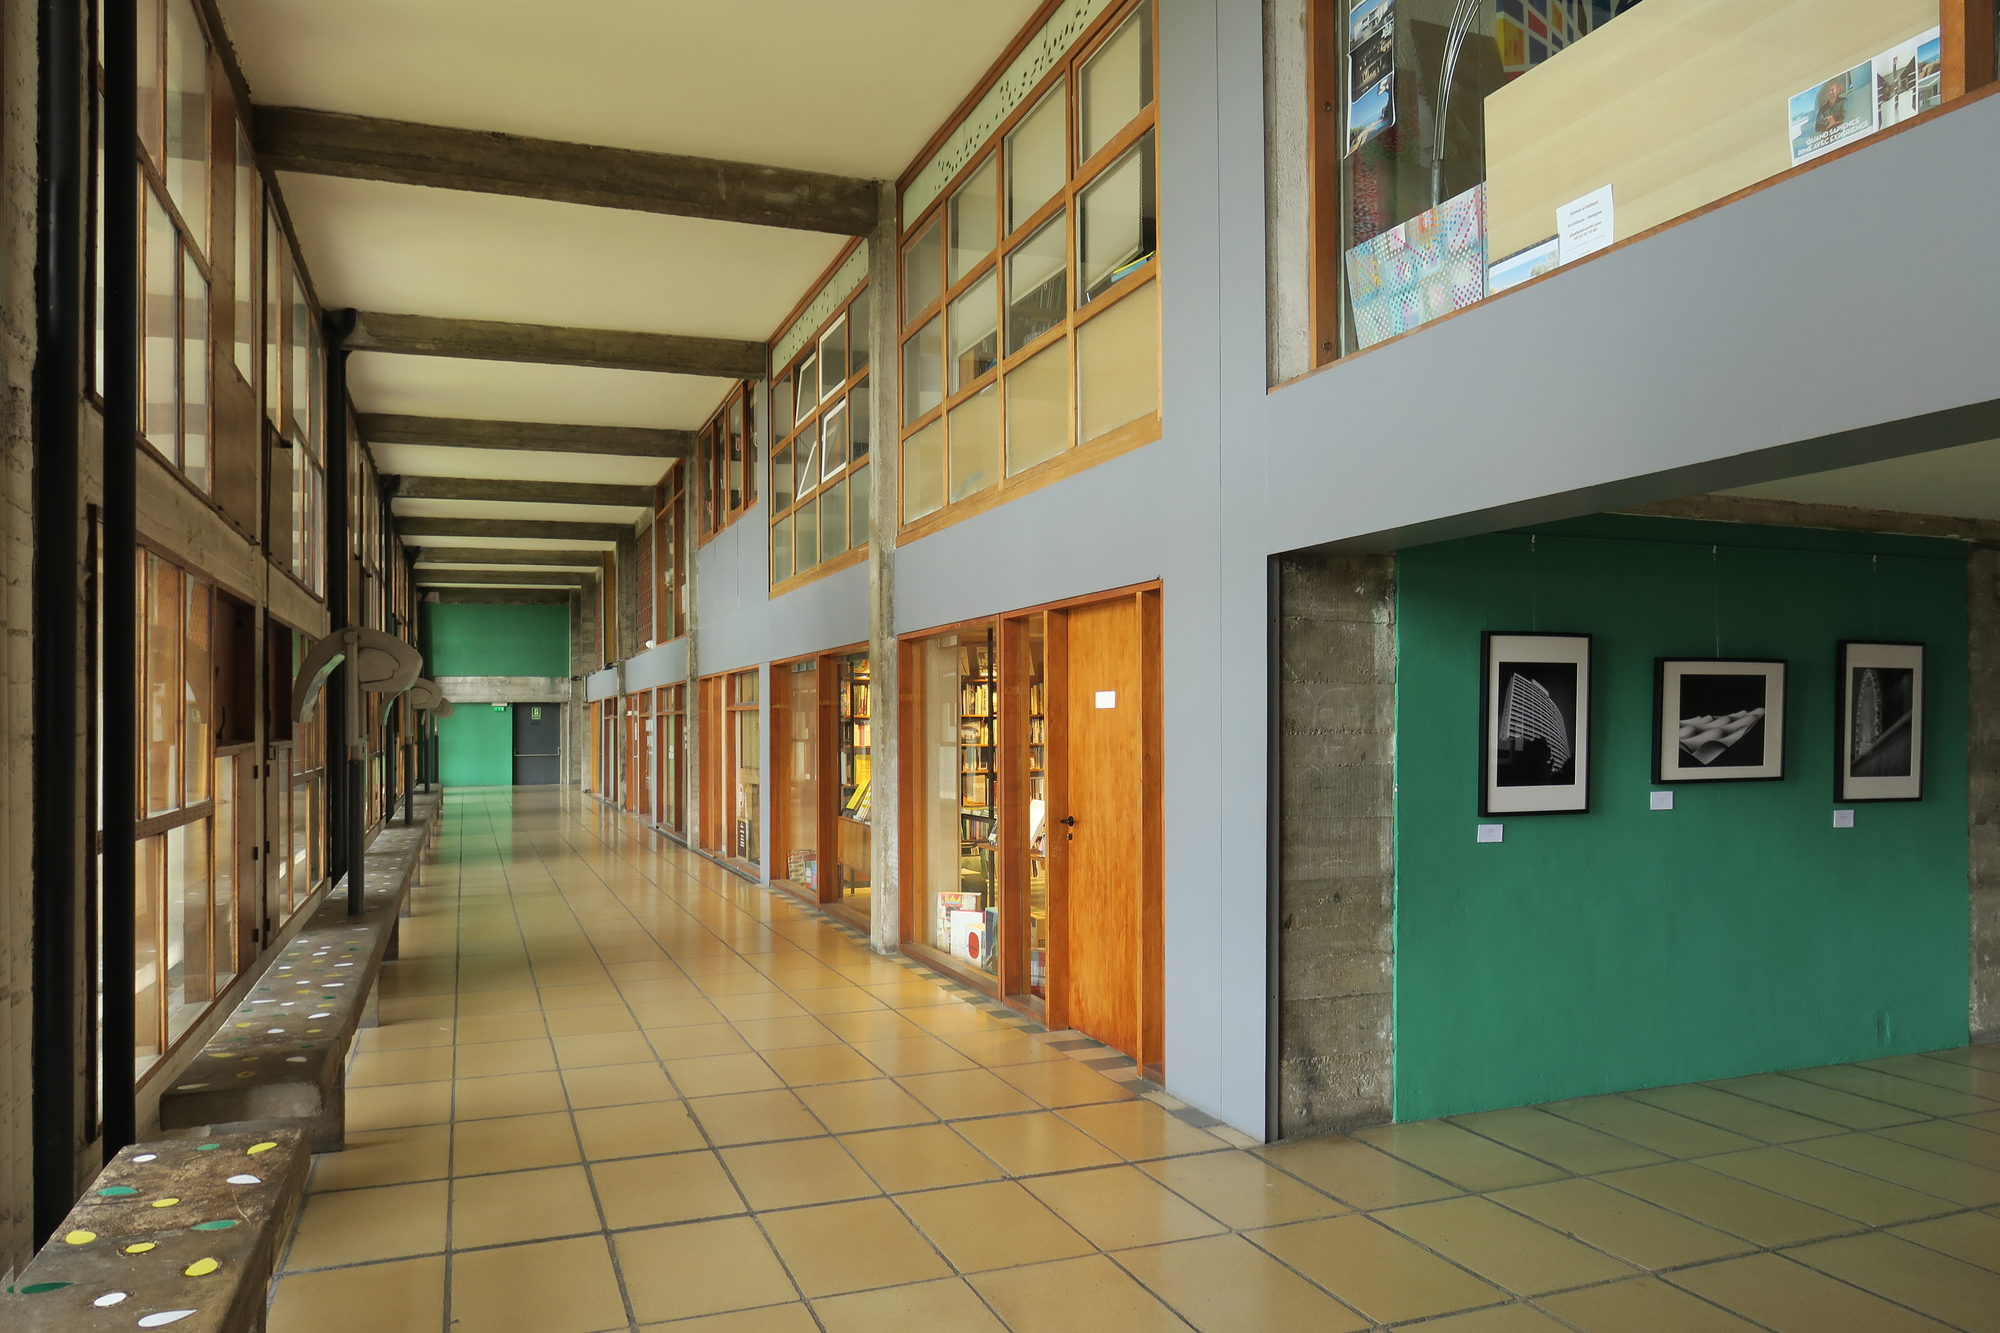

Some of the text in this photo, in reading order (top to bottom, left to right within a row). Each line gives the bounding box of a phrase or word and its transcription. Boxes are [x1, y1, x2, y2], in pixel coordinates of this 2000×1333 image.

[1806, 117, 1860, 145] QUAND SAPIENCE
[1797, 144, 1813, 156] RIME
[1813, 139, 1830, 150] AVEC
